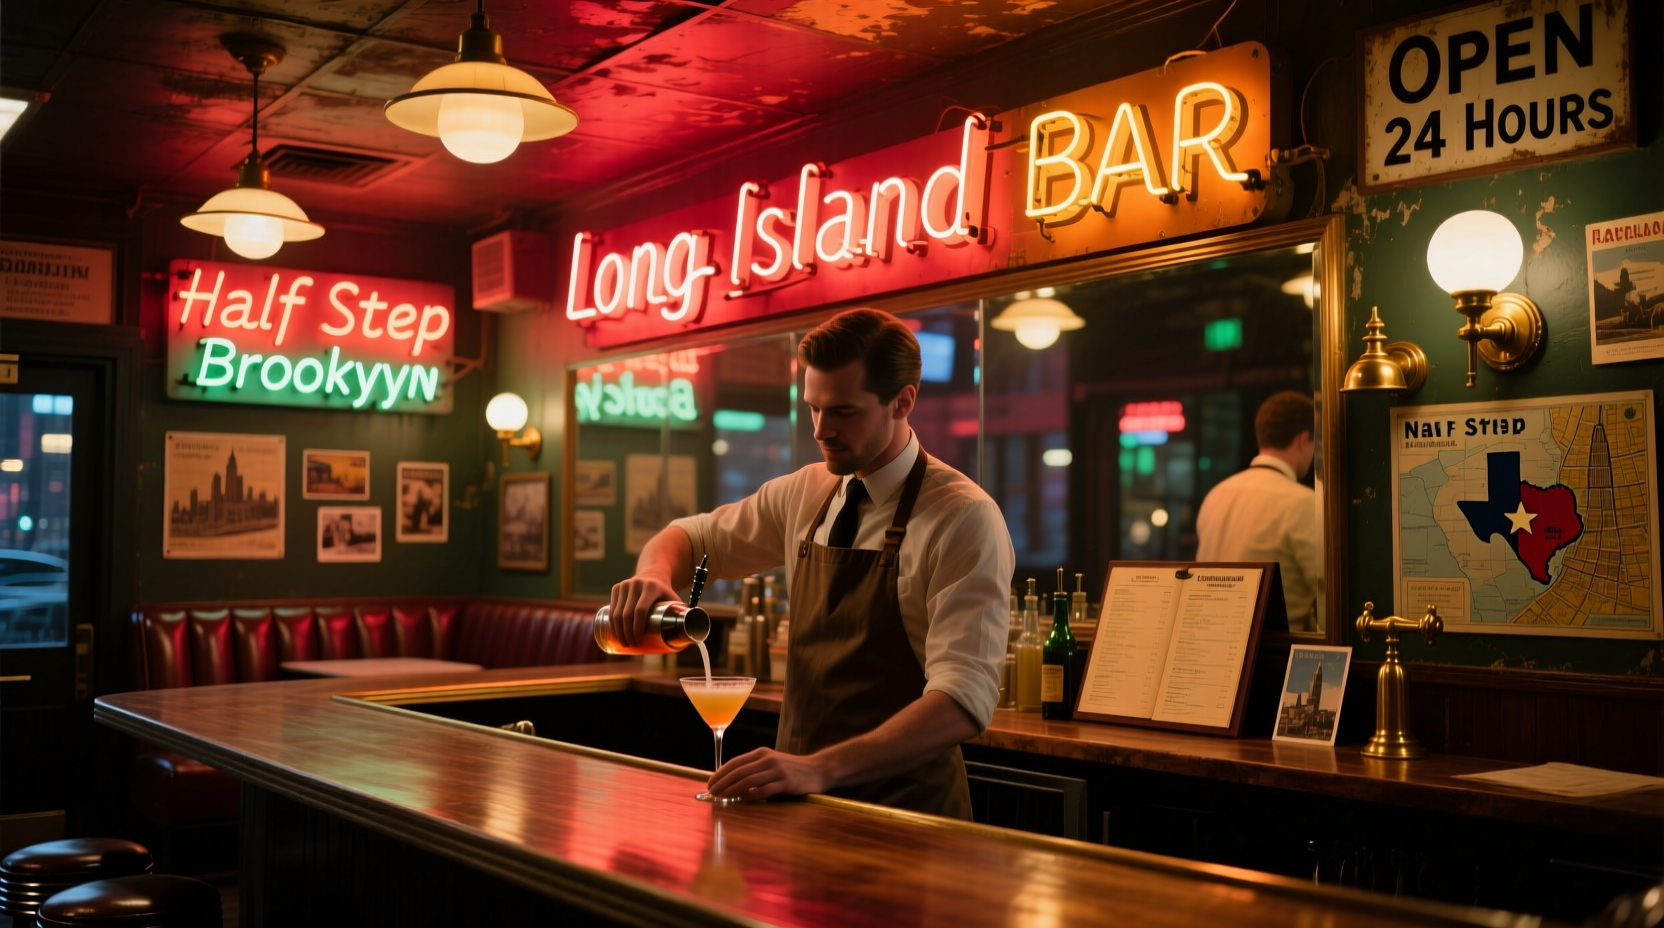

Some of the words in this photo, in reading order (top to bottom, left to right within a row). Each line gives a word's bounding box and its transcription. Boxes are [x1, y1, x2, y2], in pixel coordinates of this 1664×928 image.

[1388, 3, 1594, 104] OPEN
[1384, 110, 1446, 167] 24
[566, 231, 718, 321] Long
[728, 110, 990, 299] Island
[1025, 81, 1254, 218] BAR
[179, 268, 314, 346] Half
[321, 281, 451, 356] Step
